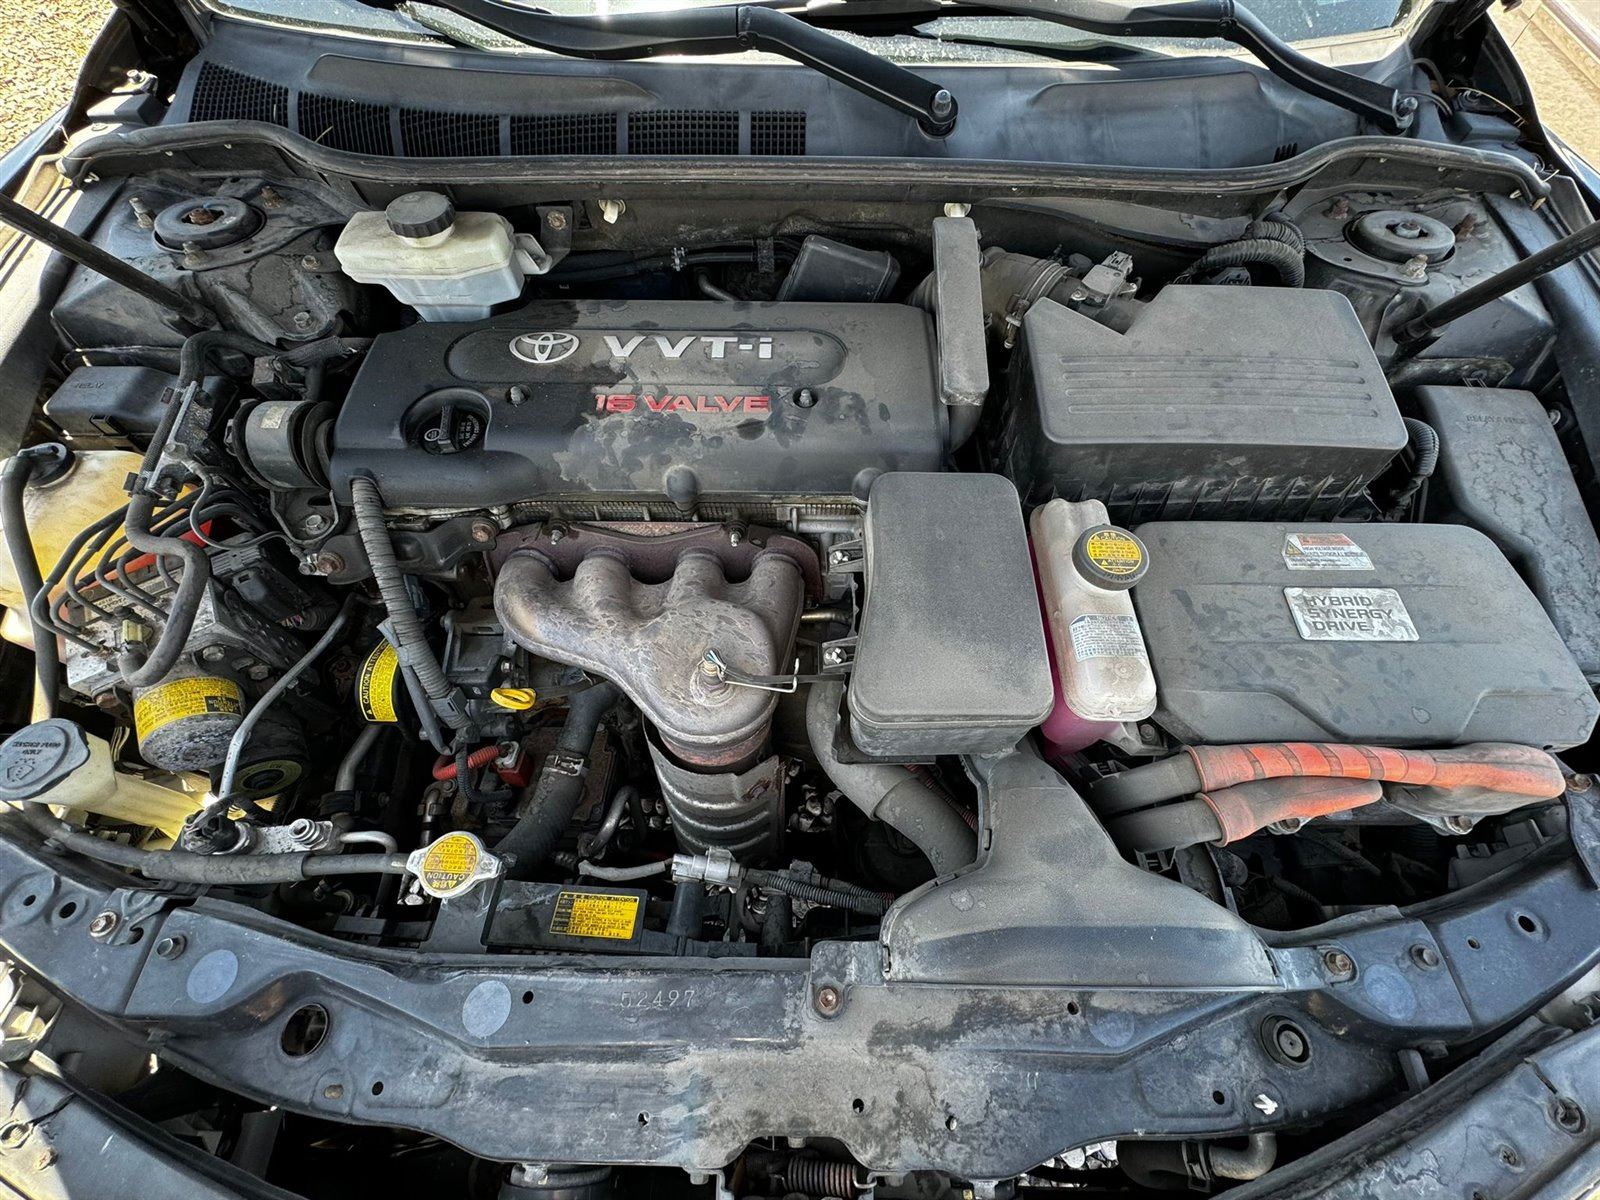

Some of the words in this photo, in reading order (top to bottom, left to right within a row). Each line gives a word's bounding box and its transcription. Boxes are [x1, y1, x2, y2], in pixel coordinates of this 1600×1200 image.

[603, 335, 774, 359] VVT-i
[594, 395, 637, 413] 16
[641, 395, 773, 413] VALVE
[1303, 595, 1373, 607] HYBRID
[1307, 608, 1393, 619] SYNERGY
[1313, 621, 1372, 632] DRIVE
[362, 673, 371, 705] CAUTION
[426, 872, 466, 881] CAUTION
[620, 989, 695, 1008] 52497
